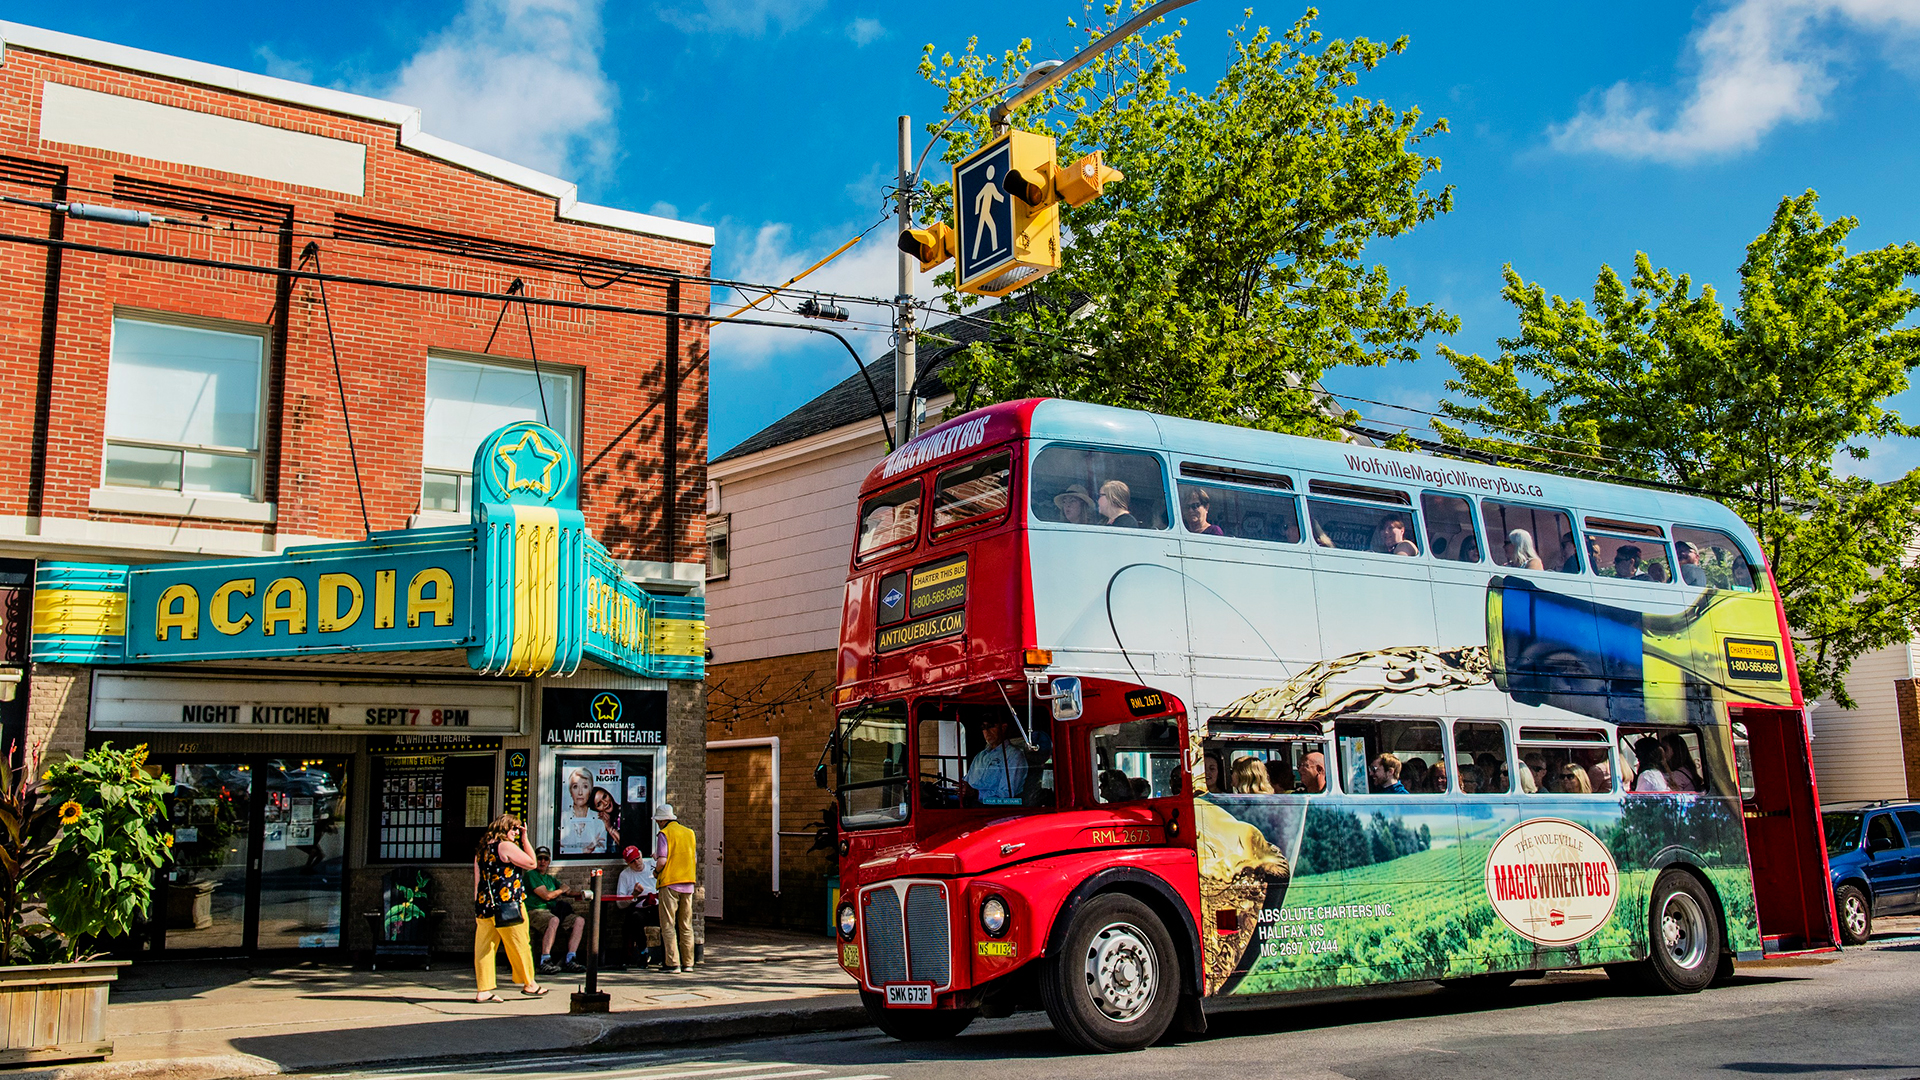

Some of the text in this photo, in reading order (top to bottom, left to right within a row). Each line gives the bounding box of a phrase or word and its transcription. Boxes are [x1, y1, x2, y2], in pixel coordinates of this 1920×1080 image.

[882, 414, 991, 480] MAGICWINERYBUS
[1344, 453, 1544, 498] WolfvilleMagicWineryBus.ca
[914, 564, 966, 586] CHARTER THIS BUS
[156, 568, 454, 640] ACADIA
[912, 583, 964, 610] 1-800-565-9662
[588, 574, 651, 656] ACADIA
[879, 614, 962, 648] ANTIQUEBUS.COM
[1730, 646, 1774, 658] CHARTER THIS BUS
[1731, 661, 1779, 673] 1-800-565-9662
[1130, 695, 1161, 709] RML 2673
[182, 705, 239, 723] NIGHT
[252, 706, 329, 724] KITCHEN
[431, 709, 469, 726] 8PM
[602, 722, 635, 730] CINEMA'S
[395, 735, 405, 744] AL
[547, 729, 661, 743] AL WHITTLE THEATRE
[384, 756, 445, 766] UPCOMING EVENTS
[1092, 829, 1151, 844] RML 2673
[1514, 833, 1584, 853] THE WOLFVILLE
[1494, 862, 1610, 901] MAGICWINERYBUS
[1257, 903, 1396, 923] ABSOLUTE CHARTERS INC.
[1258, 923, 1325, 940] HALIFAX, NS
[1260, 940, 1339, 958] MC 2697 X2444
[889, 987, 928, 1002] SMK 673F
